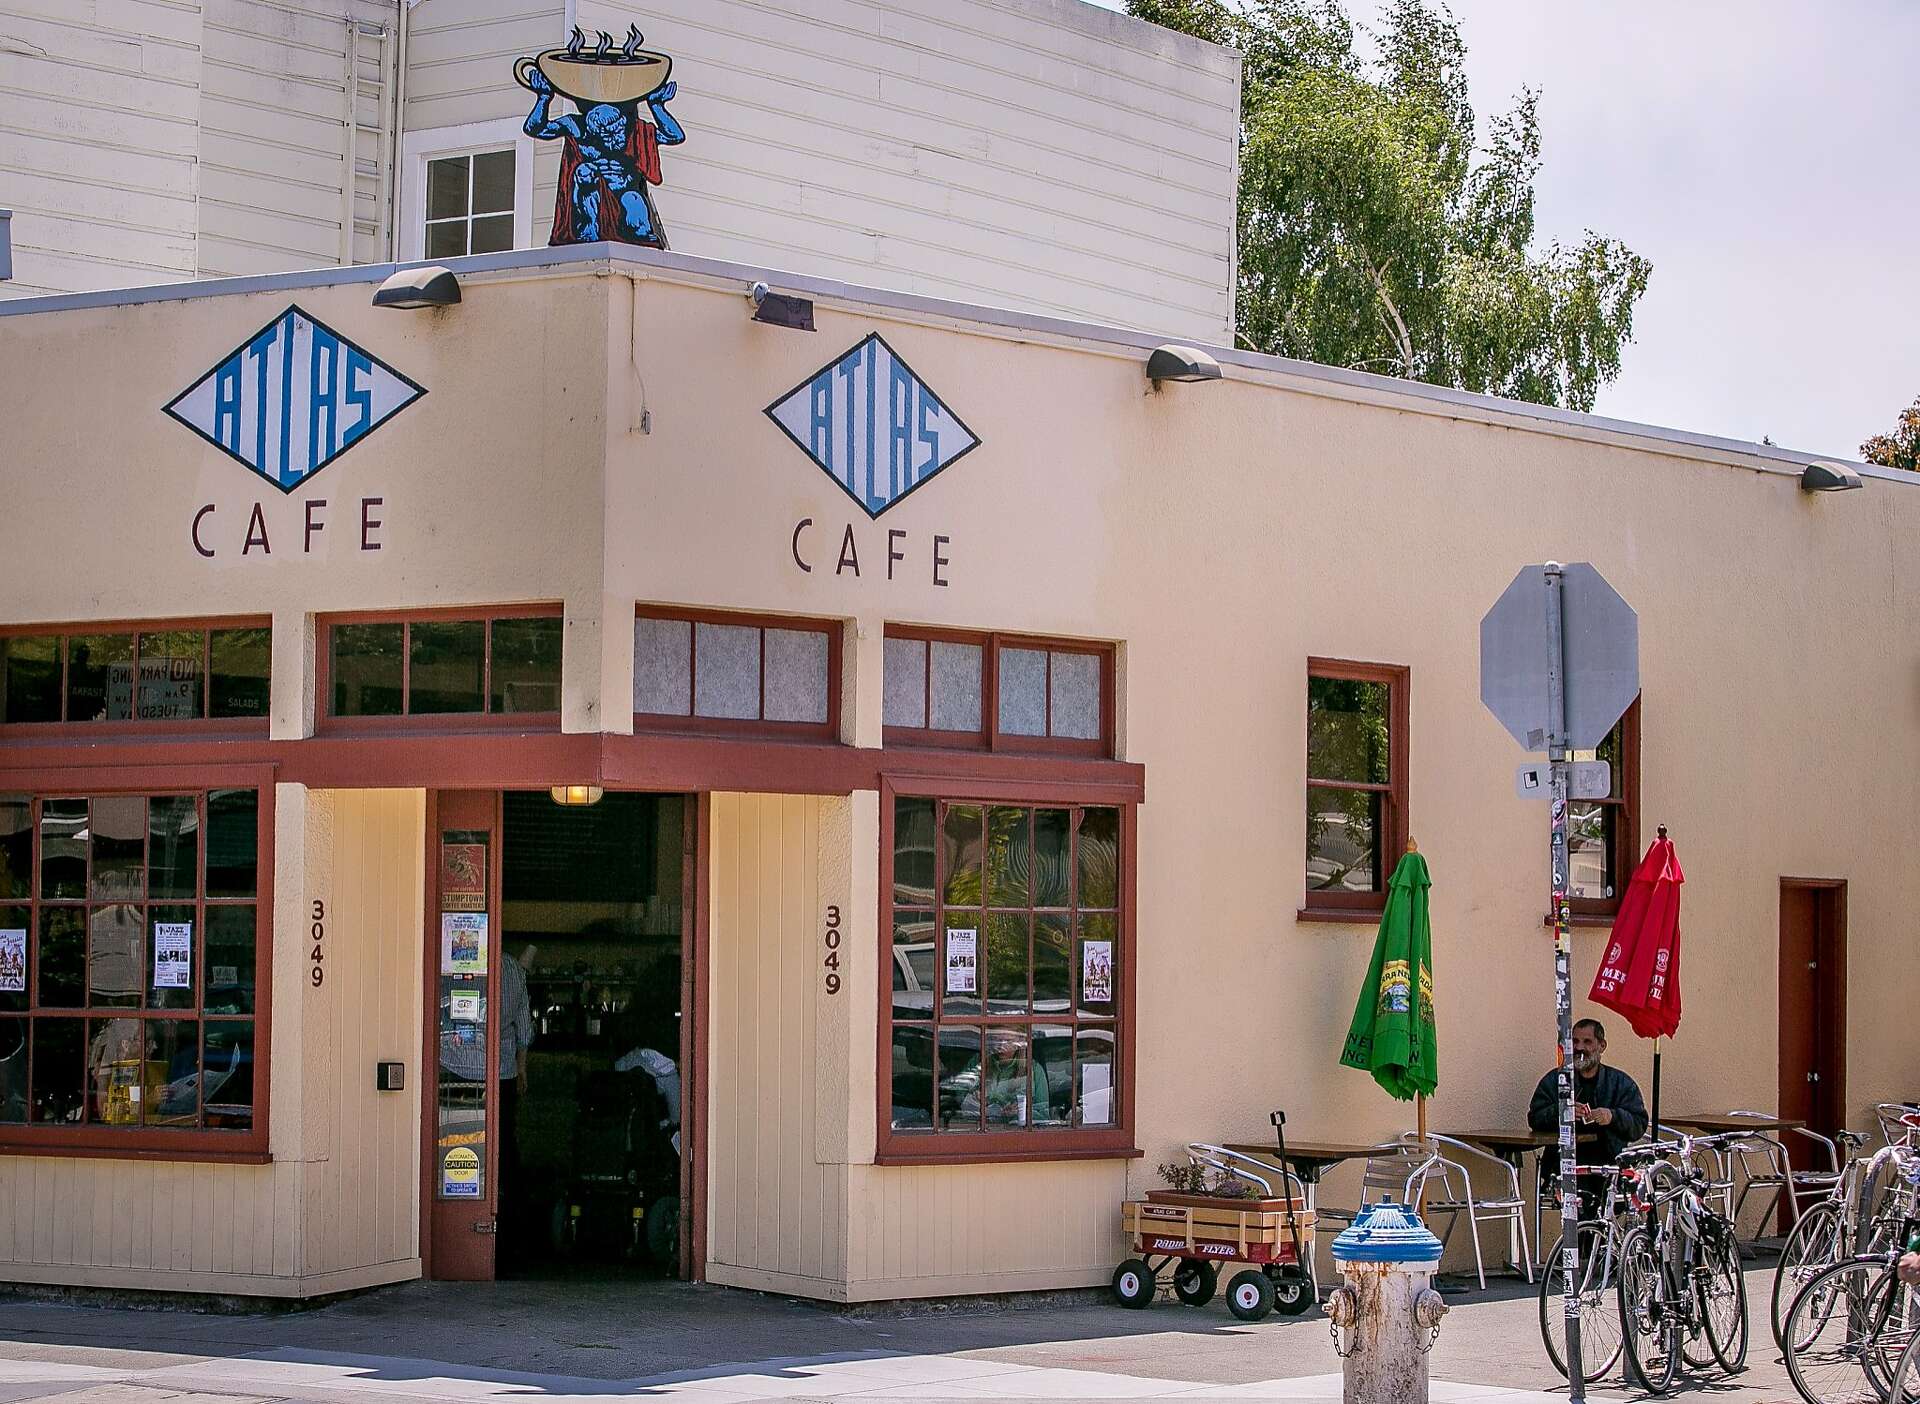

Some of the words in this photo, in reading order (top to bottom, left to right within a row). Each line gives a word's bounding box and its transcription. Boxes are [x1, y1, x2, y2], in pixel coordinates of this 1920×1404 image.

[214, 312, 373, 488] ATLAS
[810, 338, 940, 513] ATLAS
[192, 497, 383, 557] CAFE
[792, 518, 950, 587] CAFE
[228, 697, 260, 709] SALADS
[442, 893, 484, 902] STUMPTOWN
[311, 900, 324, 987] 3049
[824, 905, 841, 994] 3049
[1153, 1239, 1185, 1248] RADIO
[1202, 1244, 1235, 1255] FLYER
